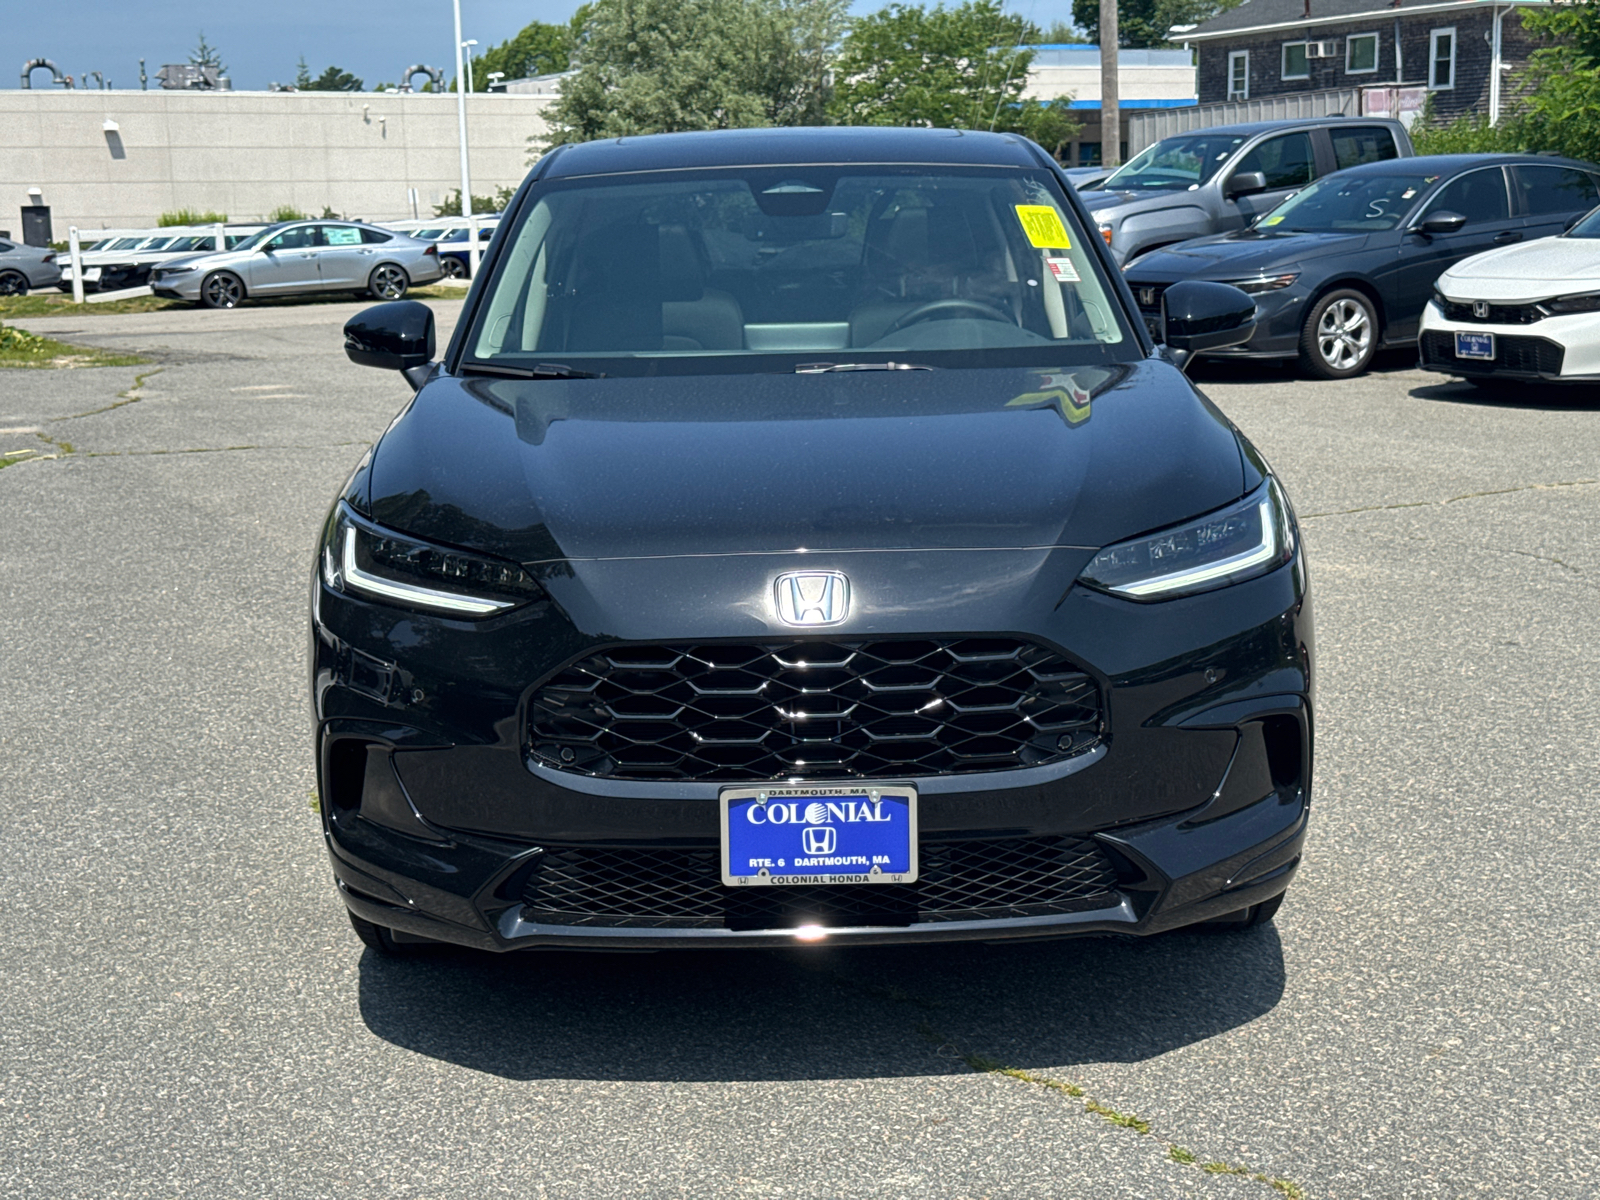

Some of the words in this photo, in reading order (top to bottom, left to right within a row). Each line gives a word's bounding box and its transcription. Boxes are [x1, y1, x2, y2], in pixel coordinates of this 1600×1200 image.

[746, 801, 892, 825] COLONIAL
[749, 858, 775, 867] RTE.
[777, 858, 786, 867] 6
[794, 856, 870, 867] DARTMOUTH,
[872, 855, 891, 864] MA
[770, 876, 827, 885] COLONIAL
[829, 875, 870, 884] HONDA
